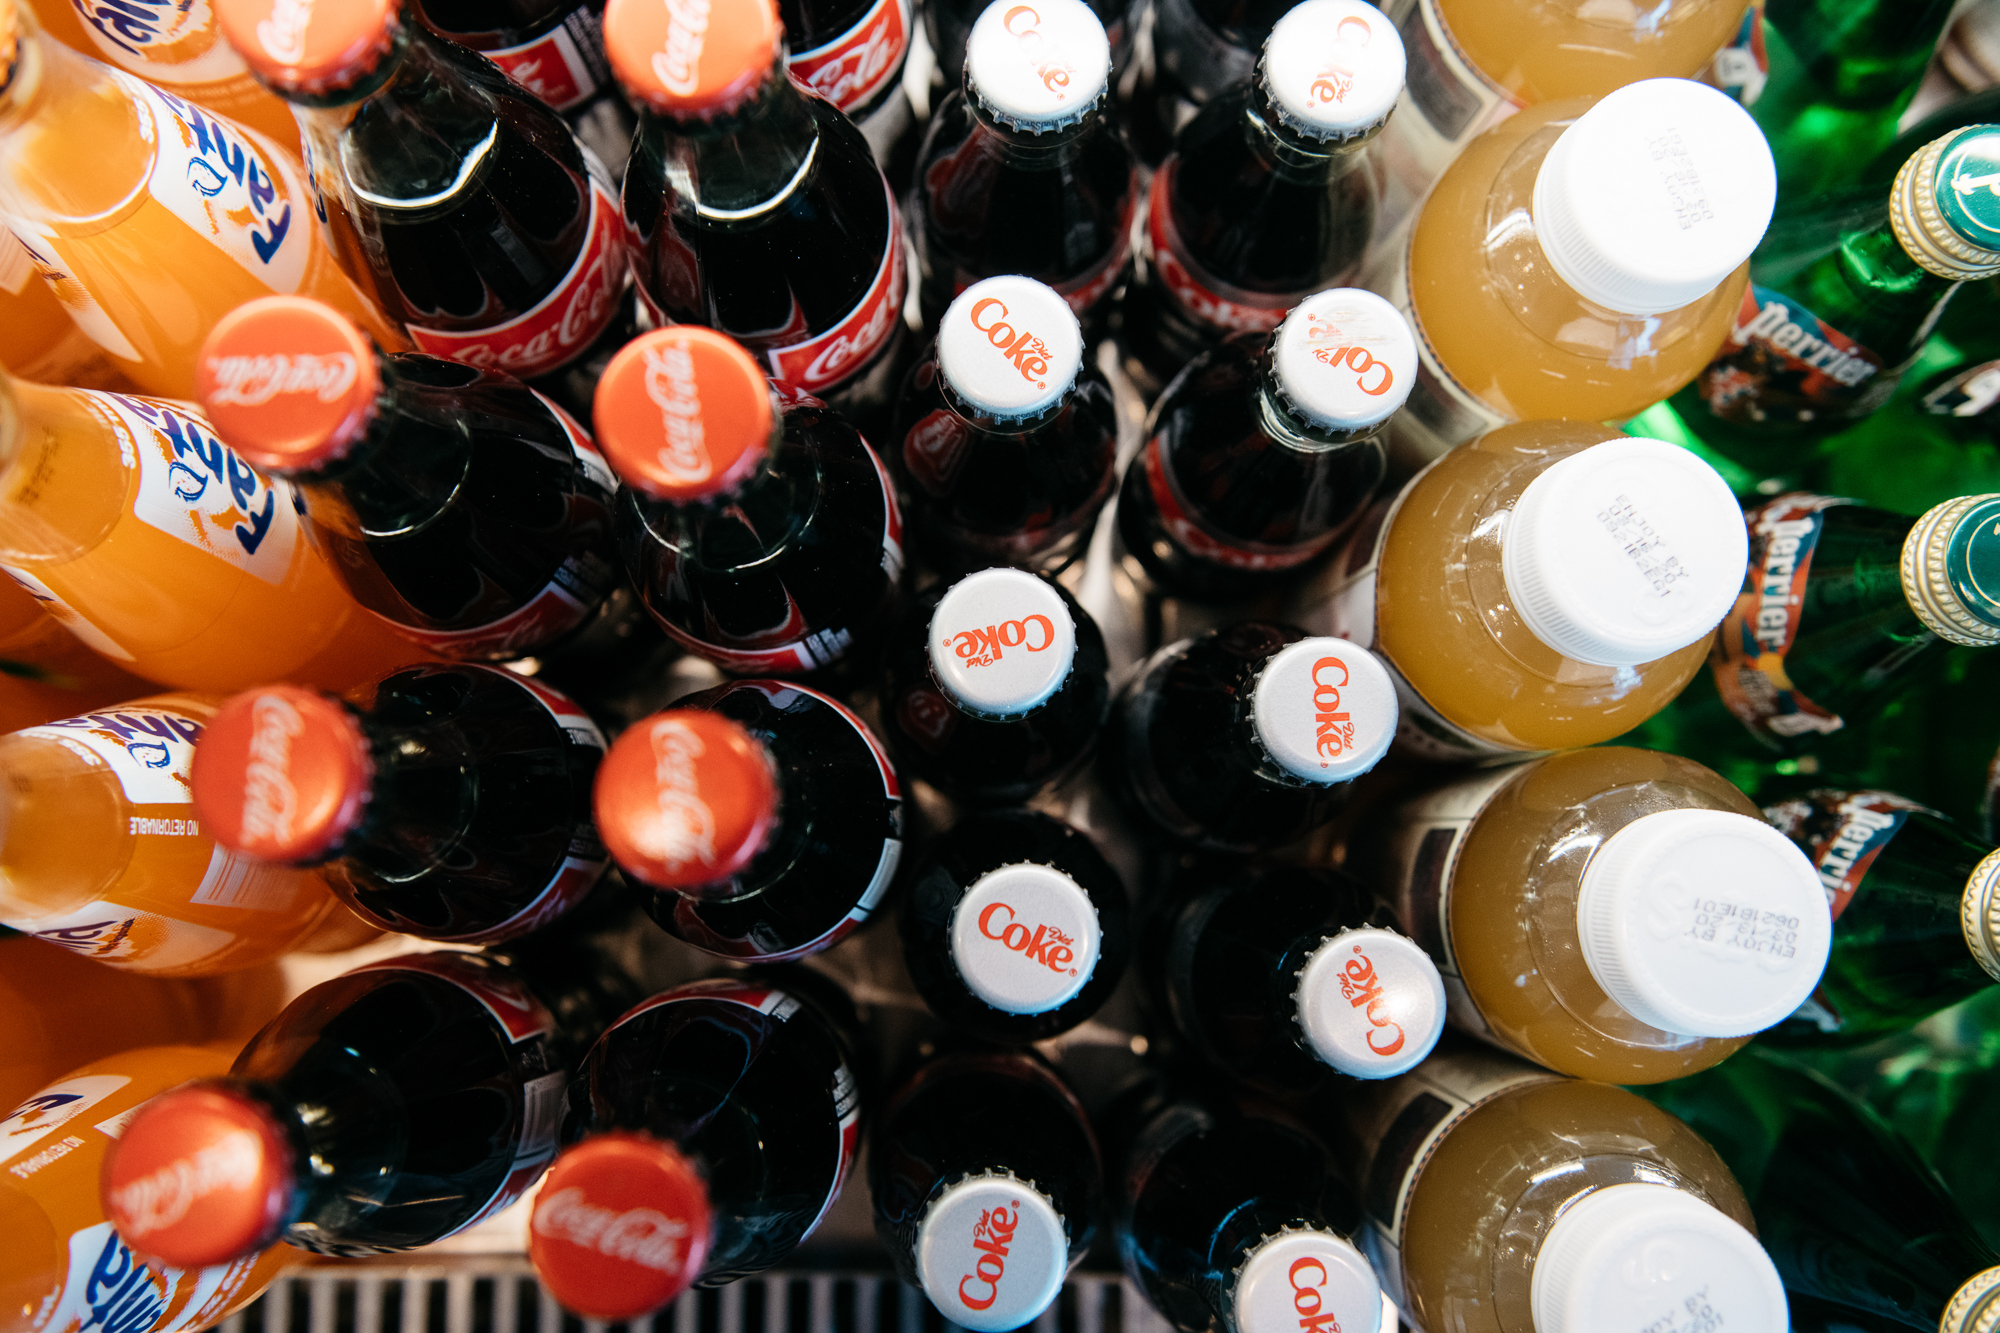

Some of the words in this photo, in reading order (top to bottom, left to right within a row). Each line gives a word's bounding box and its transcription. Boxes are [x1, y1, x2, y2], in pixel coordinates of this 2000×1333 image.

[1643, 135, 1664, 162] BY
[1658, 171, 1693, 230] ENJOY
[970, 297, 1049, 383] Coke
[1032, 336, 1054, 362] Diet
[1732, 301, 1878, 388] Perrier
[204, 352, 358, 408] Coca-Cola
[643, 339, 713, 484] Coca-Cola
[1614, 492, 1667, 546] ENJOY
[1664, 554, 1690, 578] BY
[1756, 503, 1815, 648] Perrier
[953, 613, 1055, 661] Coke
[965, 653, 994, 669] Diet
[1311, 656, 1350, 759] Coke
[1342, 721, 1356, 750] Diet
[129, 815, 187, 837] RETORNABLE
[186, 818, 200, 836] NO
[978, 902, 1074, 974] Coke
[1048, 926, 1075, 947] Diet
[1682, 925, 1716, 942] BY
[1725, 933, 1797, 959] ENJOY
[1336, 972, 1356, 1001] Diet
[1345, 954, 1406, 1057] Coke
[533, 1186, 690, 1276] Coca-Cola
[973, 1208, 991, 1240] Diet
[958, 1206, 1019, 1312] Coke
[1288, 1256, 1335, 1333] Cok
